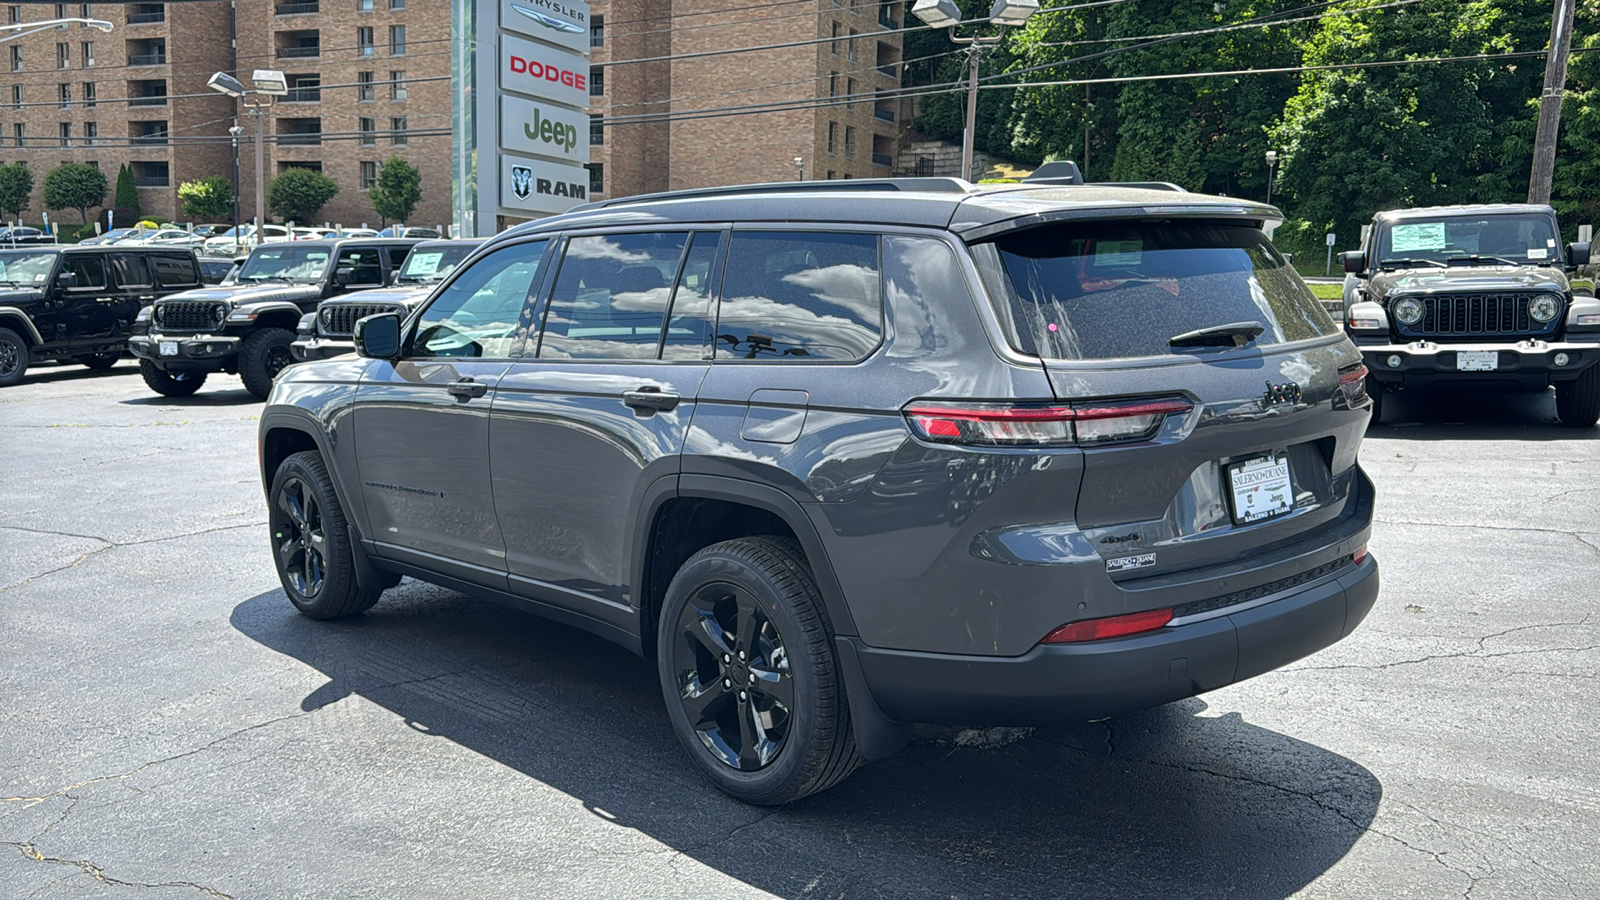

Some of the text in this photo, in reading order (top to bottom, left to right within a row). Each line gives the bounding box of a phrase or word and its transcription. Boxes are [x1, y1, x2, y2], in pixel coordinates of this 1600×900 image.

[523, 0, 585, 22] RYSLER
[510, 55, 586, 91] DODGE
[524, 108, 577, 153] Jeep
[536, 178, 586, 200] RAM
[1233, 466, 1287, 486] SALERNO DUANE
